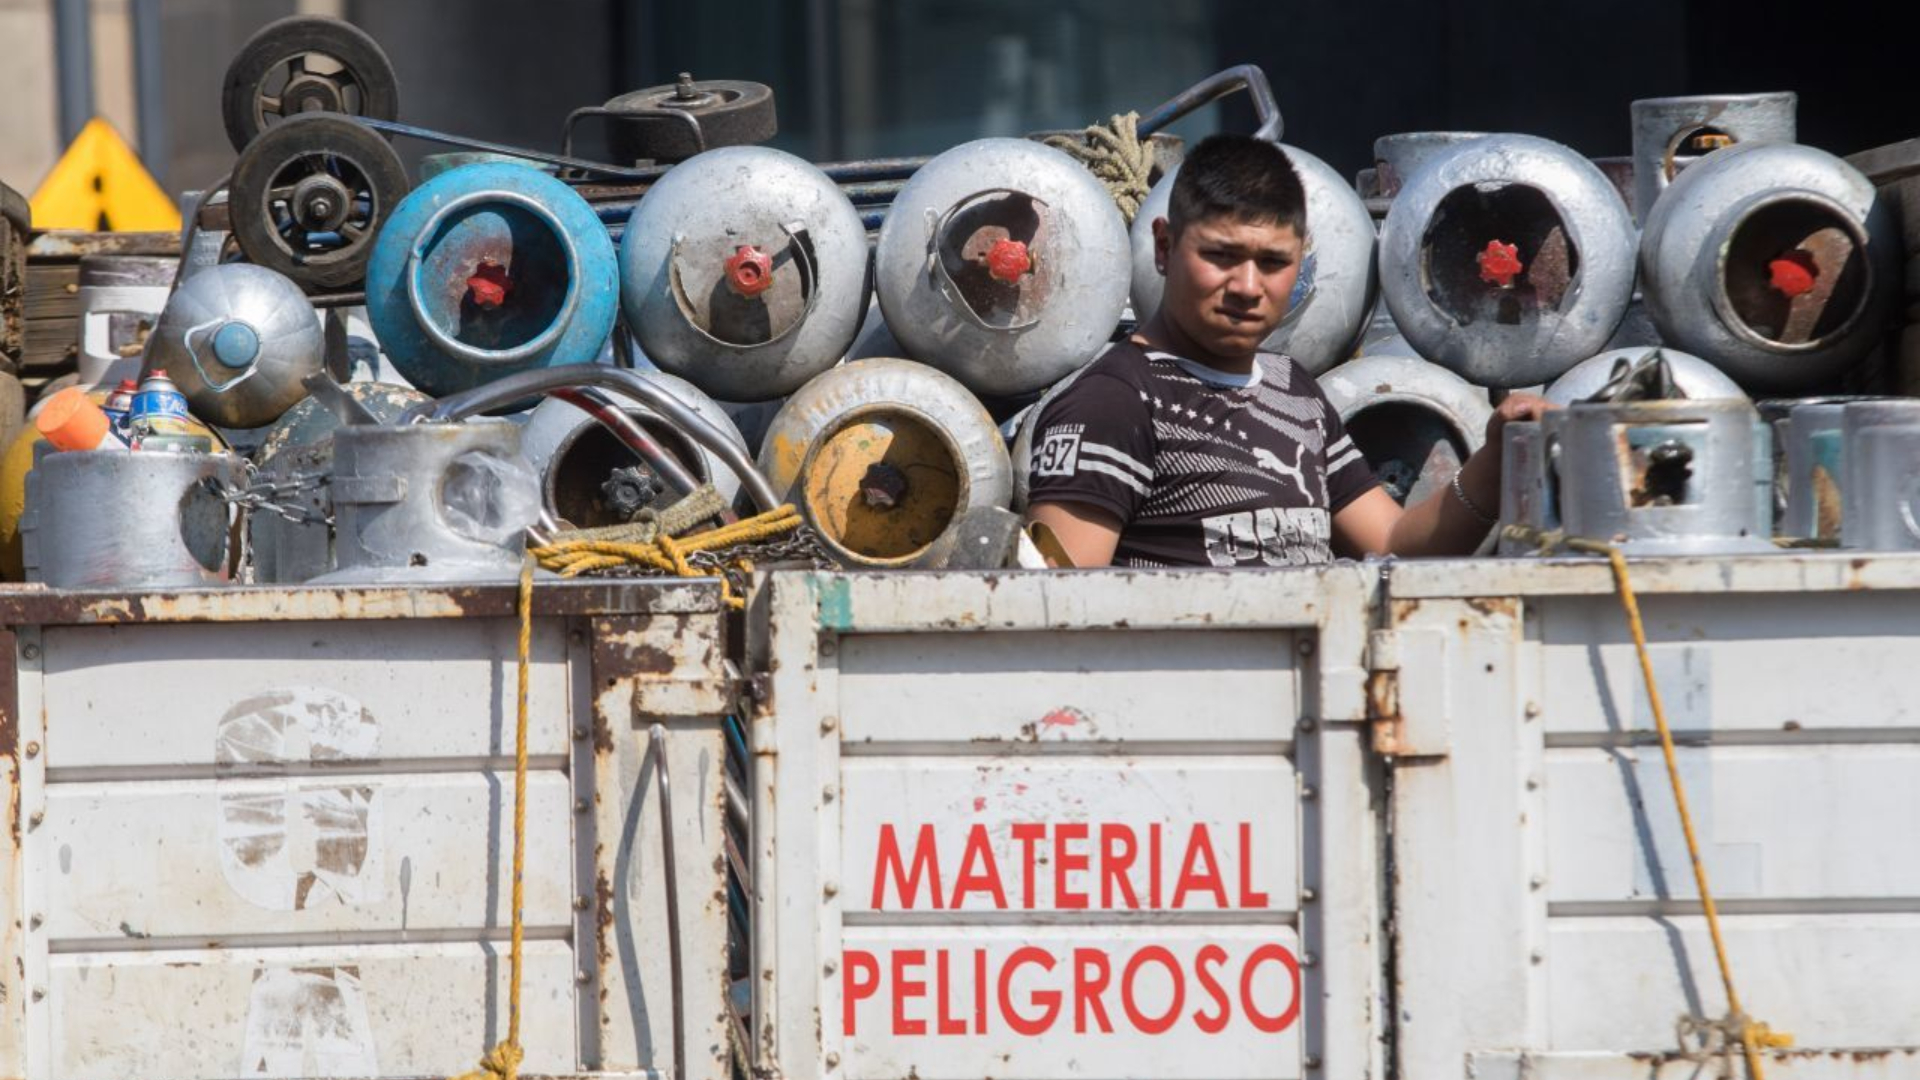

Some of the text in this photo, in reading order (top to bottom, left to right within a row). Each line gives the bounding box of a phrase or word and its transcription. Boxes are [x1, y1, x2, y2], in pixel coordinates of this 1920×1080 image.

[1043, 438, 1076, 472] 97
[871, 823, 1269, 910] MATERIAL
[843, 944, 1300, 1036] PELIGROSO
